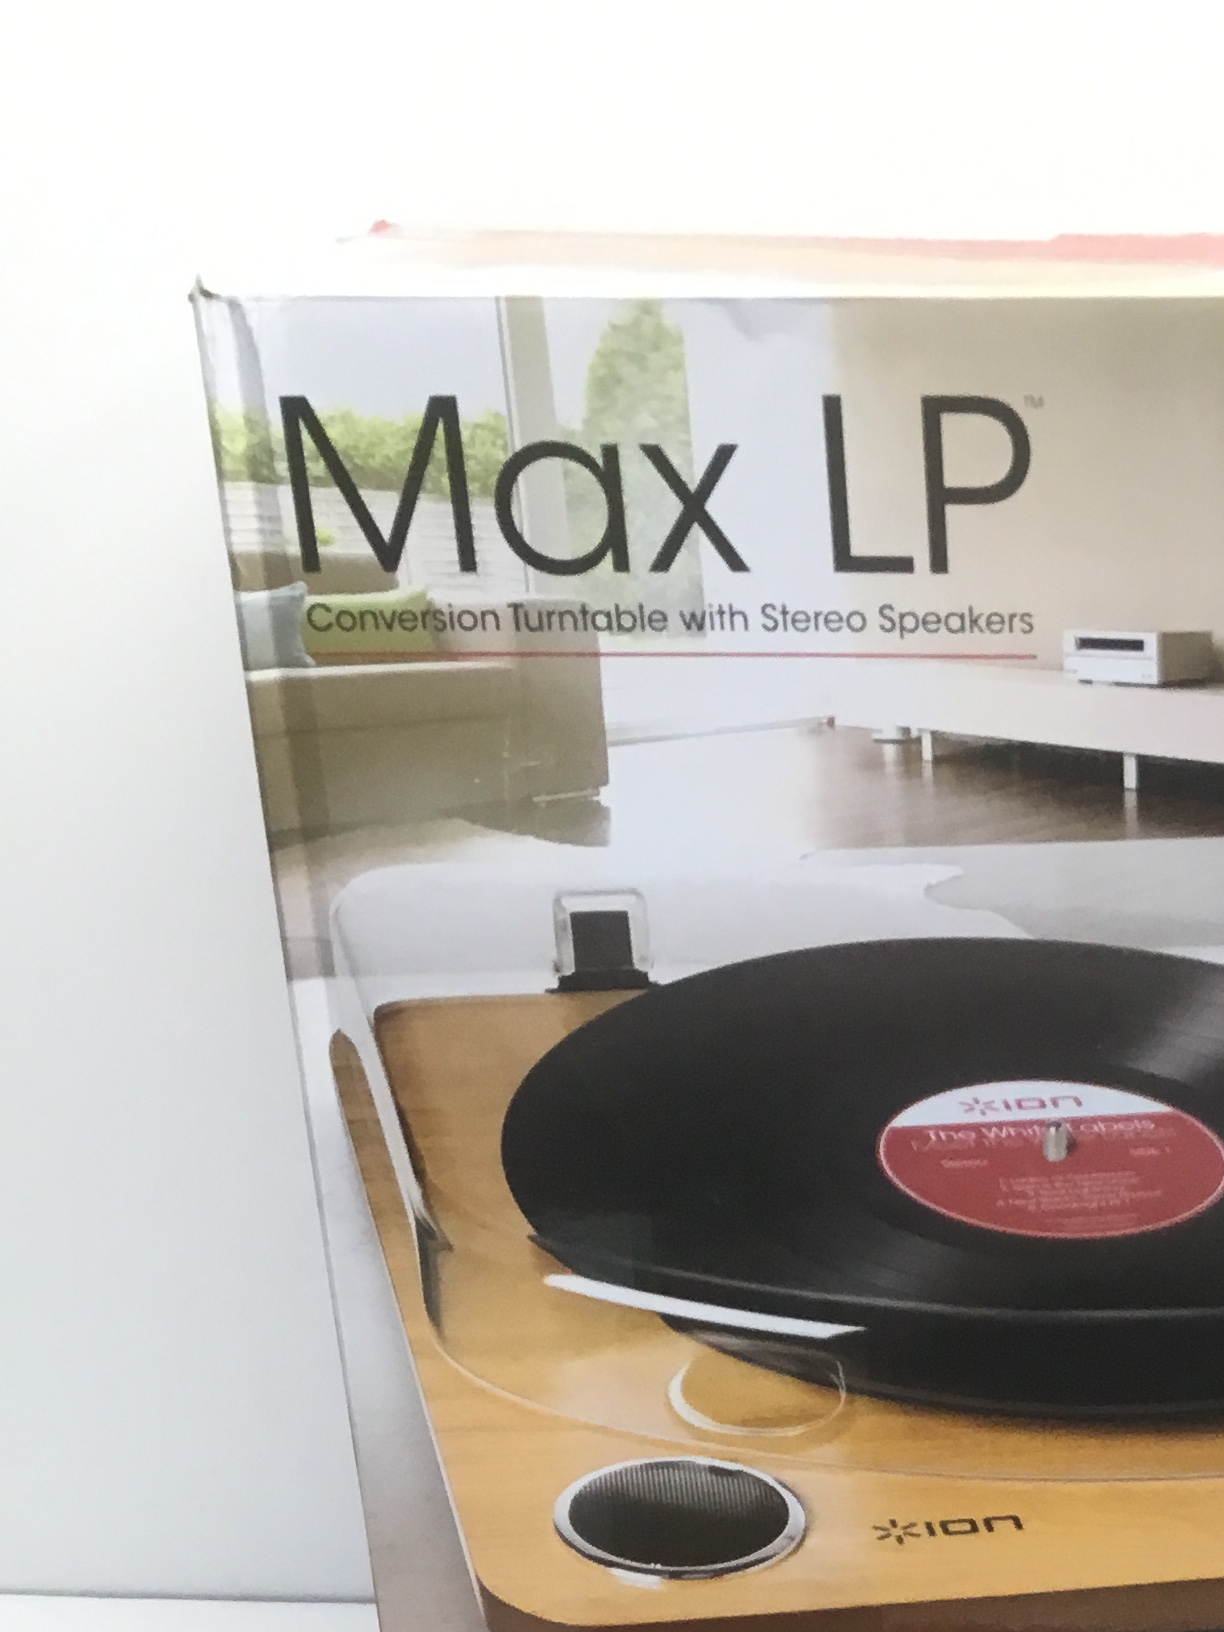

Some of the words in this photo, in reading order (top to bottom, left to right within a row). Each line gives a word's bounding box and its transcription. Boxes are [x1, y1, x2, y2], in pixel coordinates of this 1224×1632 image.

[278, 394, 750, 576] Max
[822, 393, 1033, 575] LP
[306, 602, 501, 633] Conversion
[506, 602, 669, 633] Turntable
[679, 603, 749, 633] with
[760, 603, 868, 633] Stereo
[878, 603, 1035, 639] Speakers
